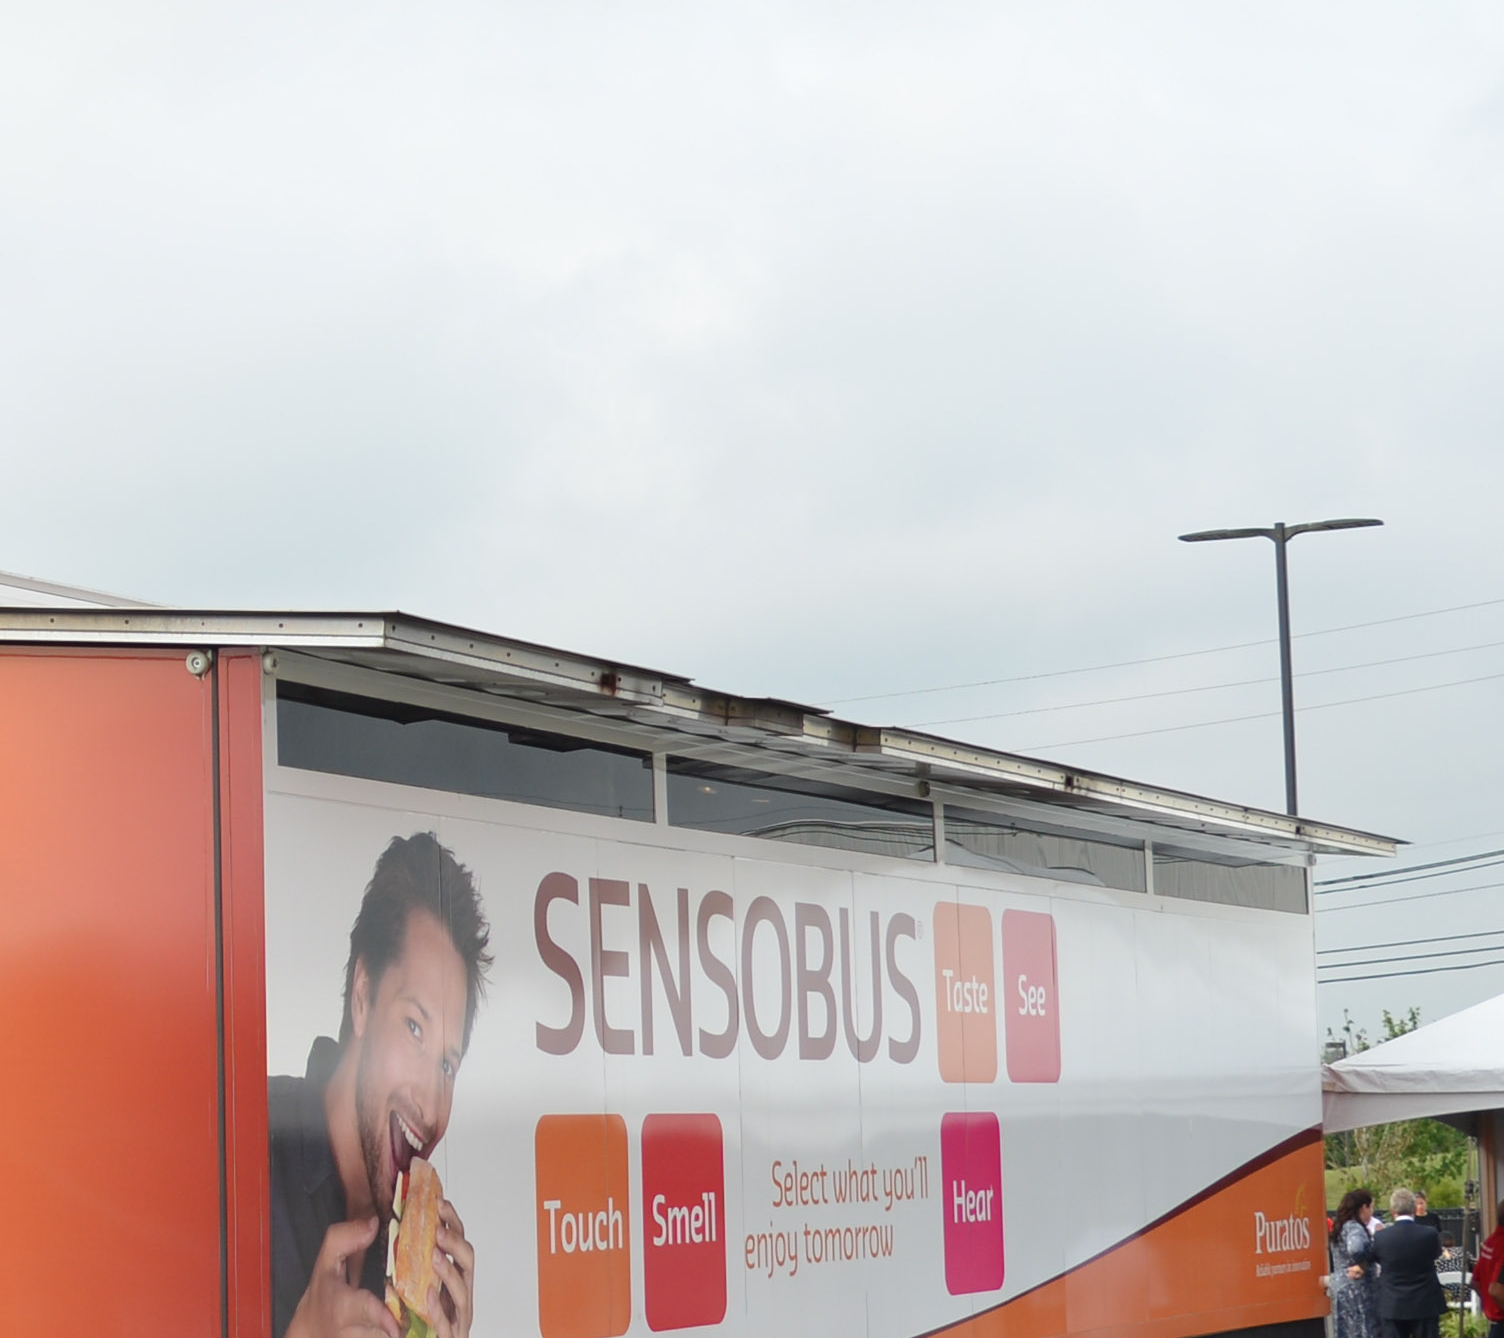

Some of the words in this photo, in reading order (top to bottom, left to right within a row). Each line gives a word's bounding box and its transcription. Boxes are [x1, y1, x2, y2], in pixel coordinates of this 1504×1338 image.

[534, 872, 921, 1064] SENSOBUS
[943, 969, 988, 1014] Taste
[1017, 974, 1046, 1017] See
[771, 1160, 827, 1208] Select
[833, 1158, 879, 1204] what
[883, 1156, 928, 1211] you'll
[953, 1180, 993, 1223] Hear
[544, 1197, 623, 1254] Touch
[652, 1192, 716, 1246] Smell
[745, 1220, 798, 1279] enjoy
[804, 1221, 894, 1262] tomorrow
[1254, 1211, 1310, 1254] Puratos
